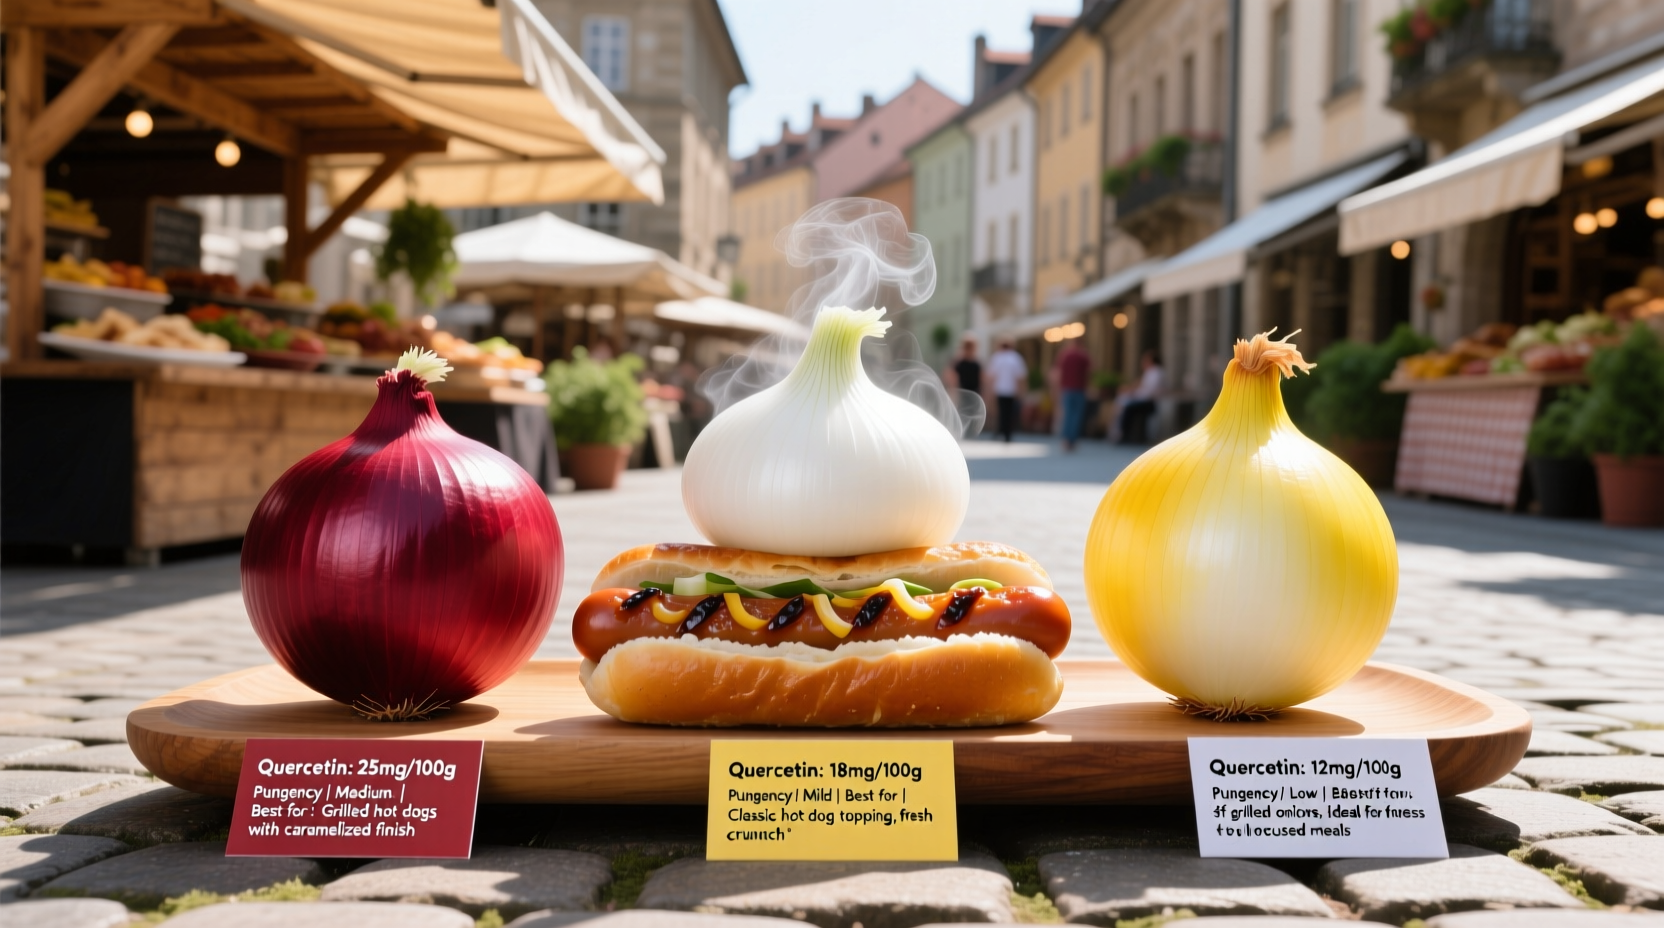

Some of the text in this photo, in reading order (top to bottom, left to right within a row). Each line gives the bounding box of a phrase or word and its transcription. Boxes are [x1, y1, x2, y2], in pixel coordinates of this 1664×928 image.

[258, 758, 456, 781] Quercetin: 25mg/100g
[729, 762, 922, 781] Quercetin: 18mg/100g
[1210, 759, 1401, 778] Quercetin: 12mg/100g
[804, 788, 832, 801] Mild
[846, 789, 873, 801] Best
[879, 789, 897, 801] for
[1290, 787, 1317, 799] Low
[251, 805, 282, 817] Best
[322, 804, 369, 817] Grilled
[374, 804, 397, 817] hot
[402, 804, 437, 821] dogs
[728, 808, 932, 825] Classic hot dog topping, fresh
[249, 823, 279, 836] with
[376, 822, 414, 836] finish
[1311, 824, 1351, 836] meals
